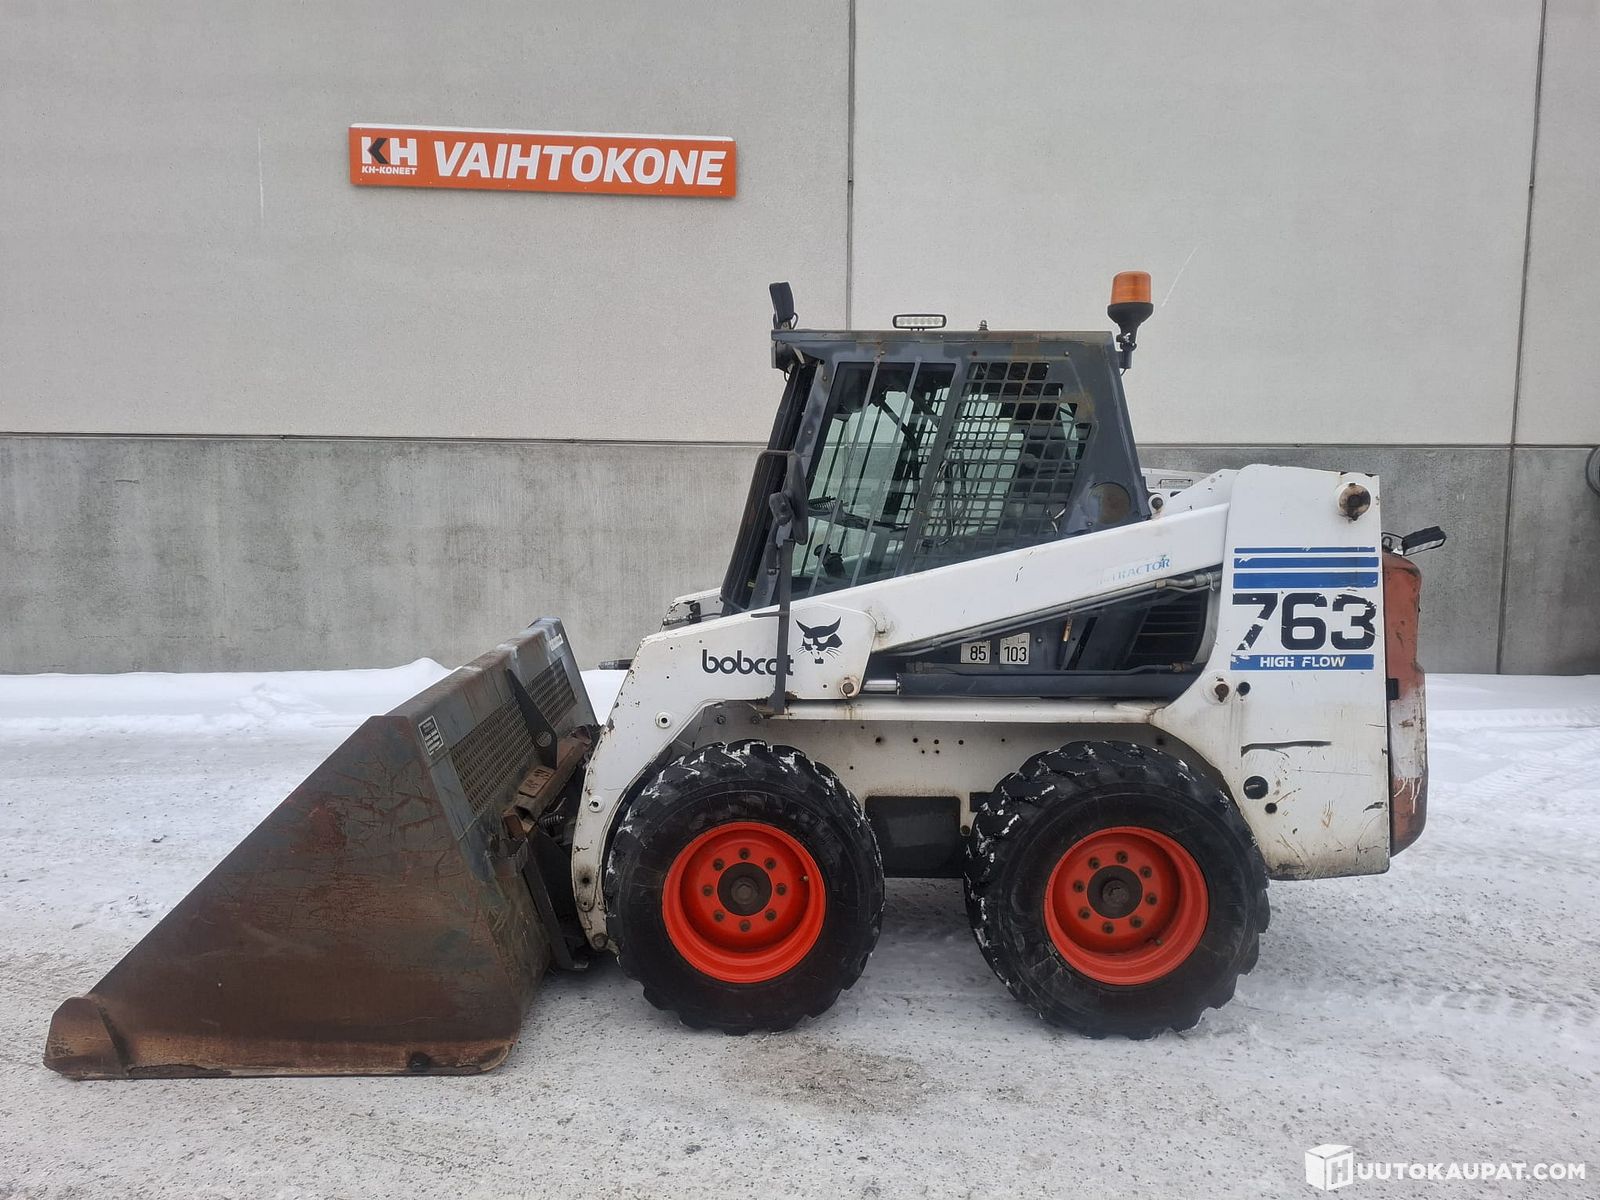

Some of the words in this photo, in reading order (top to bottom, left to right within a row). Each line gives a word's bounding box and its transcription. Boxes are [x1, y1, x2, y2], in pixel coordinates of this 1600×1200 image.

[361, 136, 418, 166] KH
[361, 165, 418, 176] KH-KONEET
[433, 140, 727, 187] VAIHTOKONE
[1232, 592, 1377, 651] 763
[702, 649, 794, 675] bobcat
[970, 645, 987, 661] 85
[1004, 646, 1027, 662] 103
[1259, 656, 1295, 668] HIGH
[1301, 656, 1346, 668] FLOW
